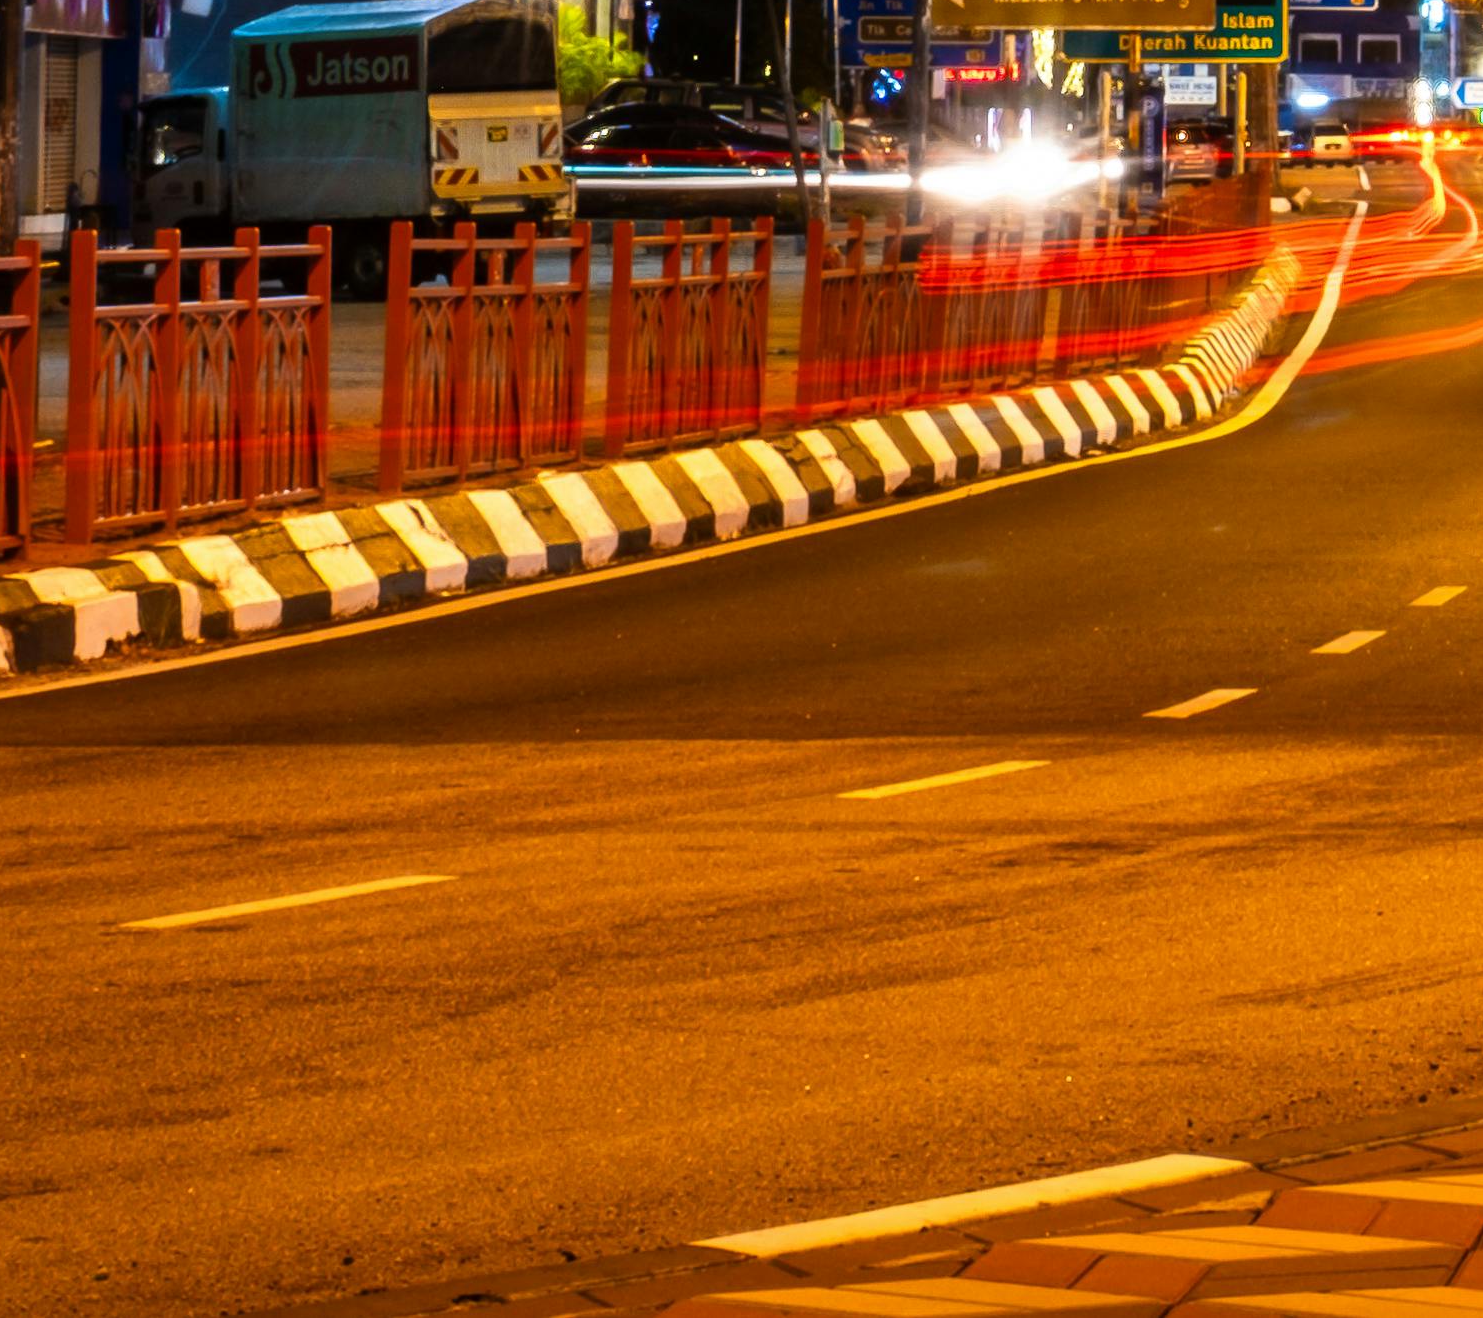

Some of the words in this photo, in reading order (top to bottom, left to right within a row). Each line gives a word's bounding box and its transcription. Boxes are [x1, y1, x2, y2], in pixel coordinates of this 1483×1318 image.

[1222, 11, 1275, 30] Islam
[1118, 33, 1187, 52] Derah
[1193, 33, 1275, 51] Kuantan
[306, 50, 410, 87] Jatson
